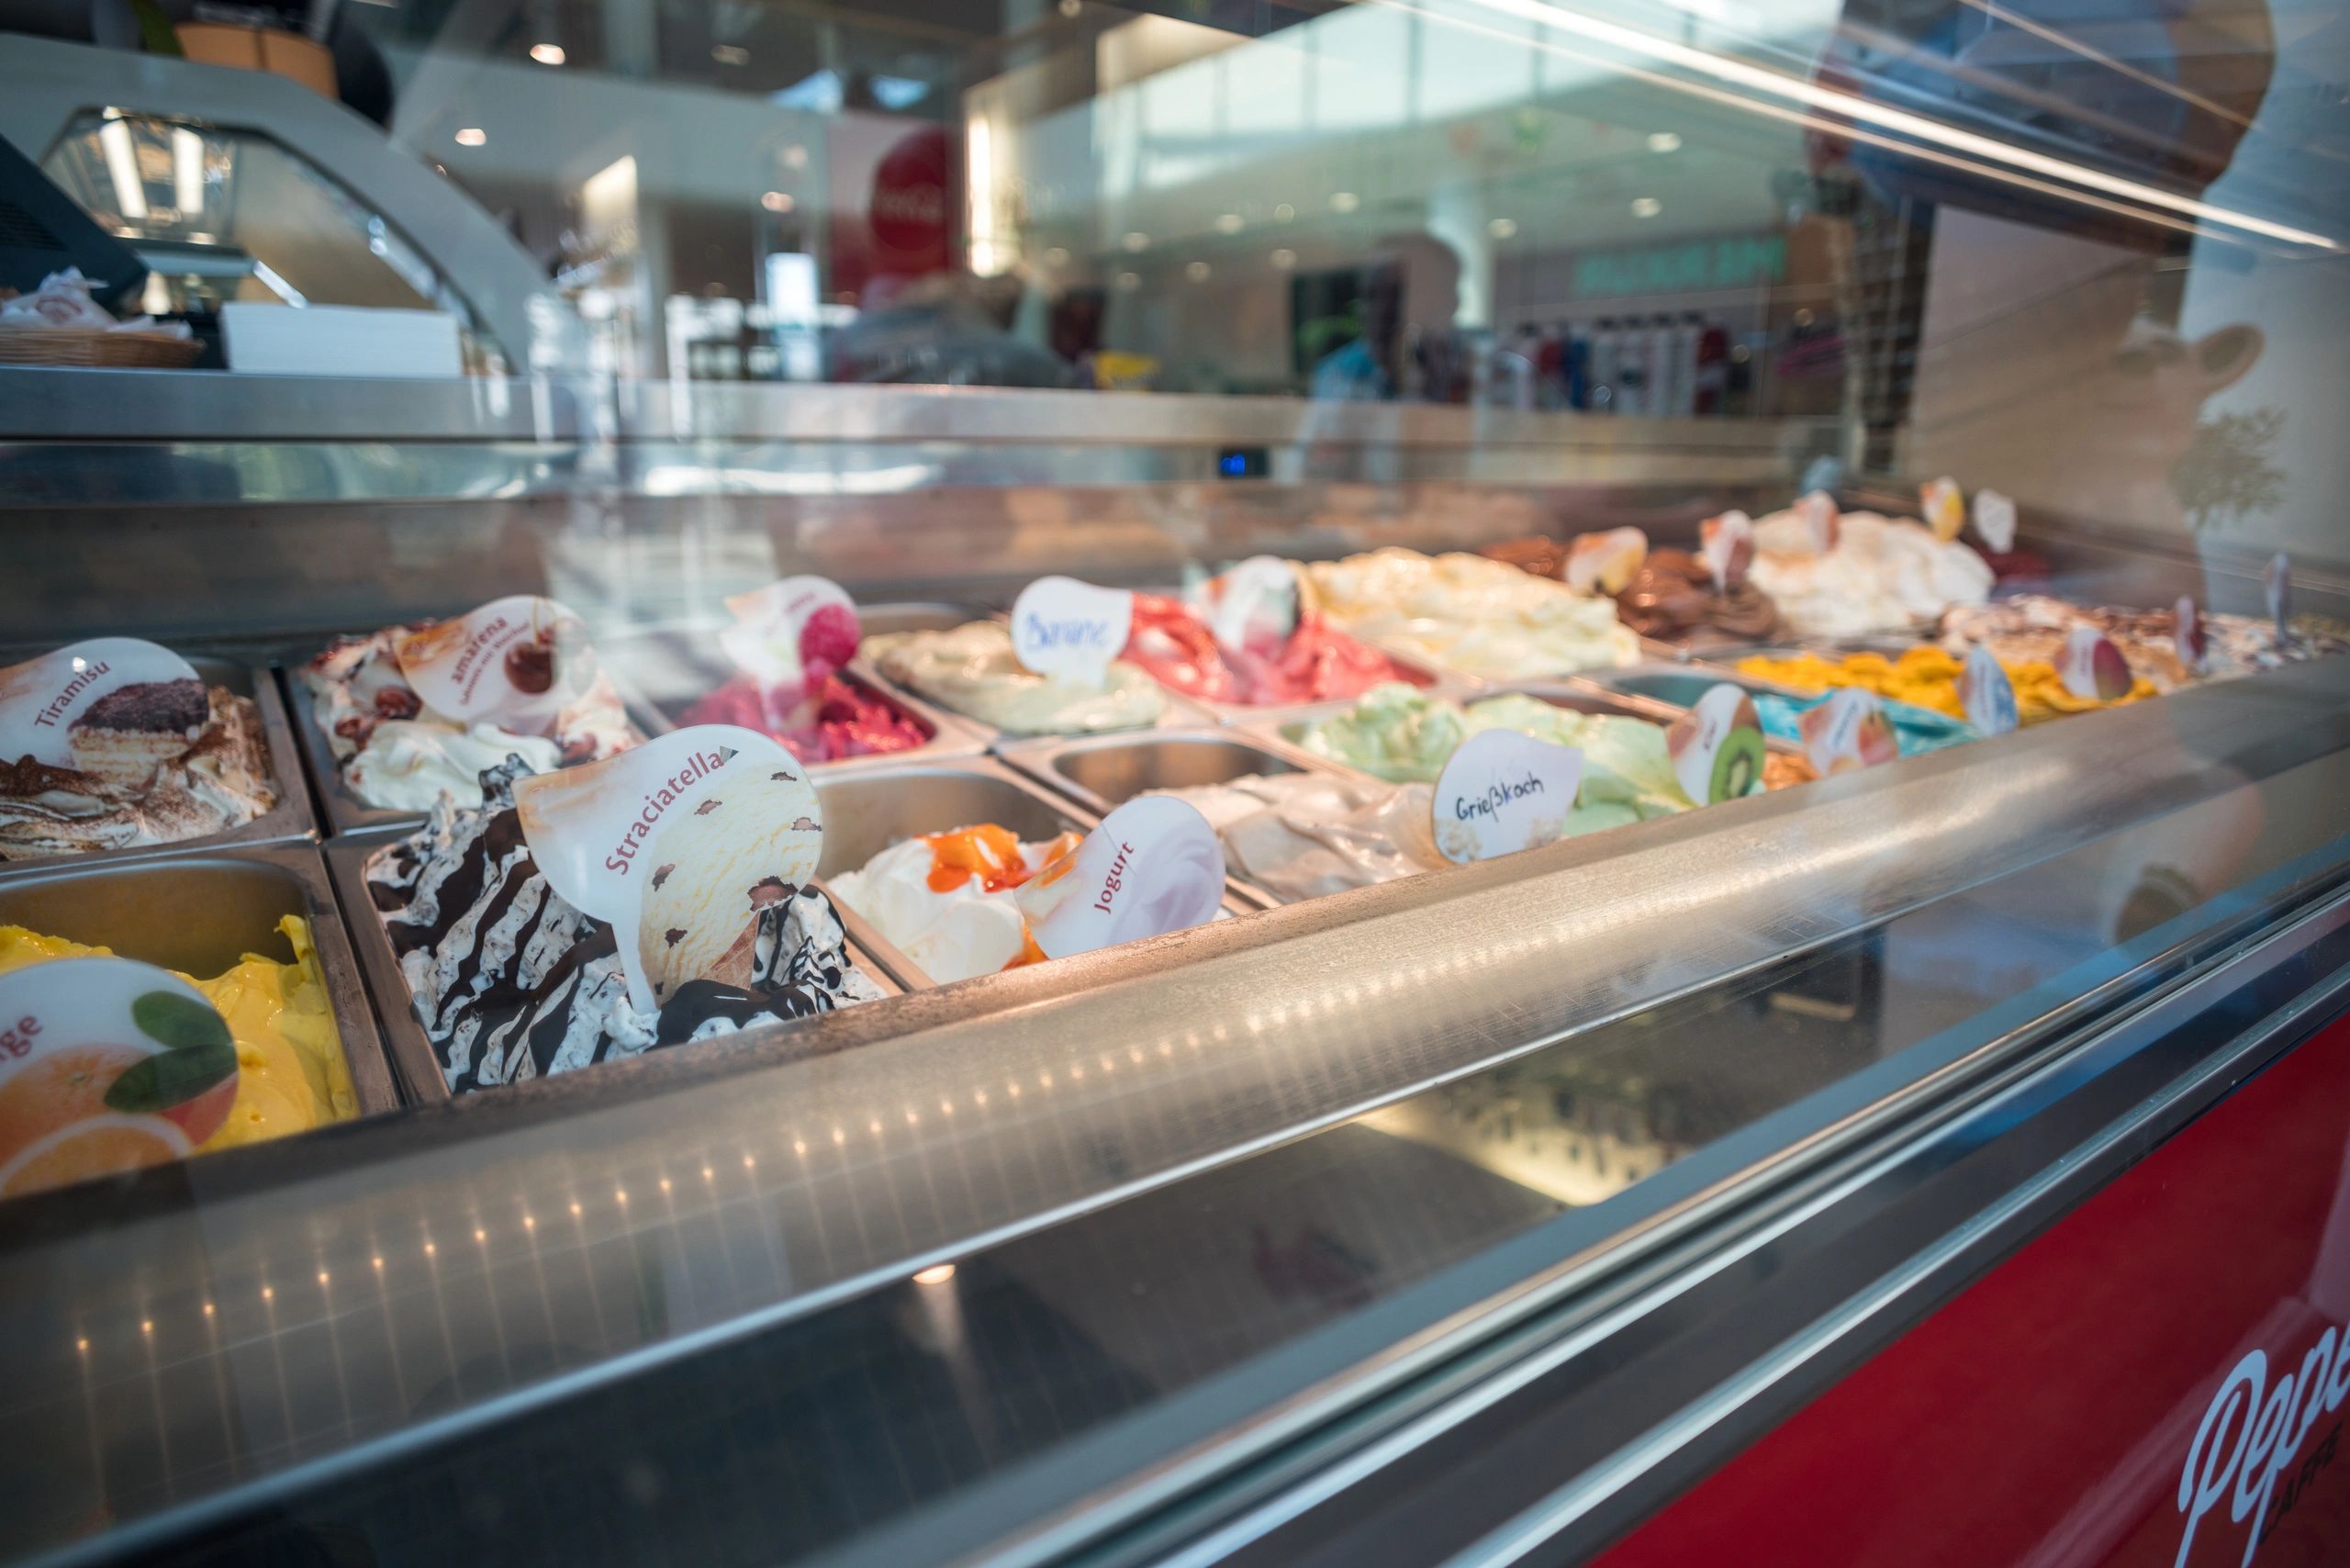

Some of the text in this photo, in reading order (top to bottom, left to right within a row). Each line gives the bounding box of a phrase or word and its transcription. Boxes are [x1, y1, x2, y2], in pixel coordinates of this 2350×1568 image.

[34, 661, 110, 726] Tiramisu
[605, 751, 725, 875] Straciatella
[1093, 841, 1134, 914] Jogurt
[0, 1015, 44, 1061] ge
